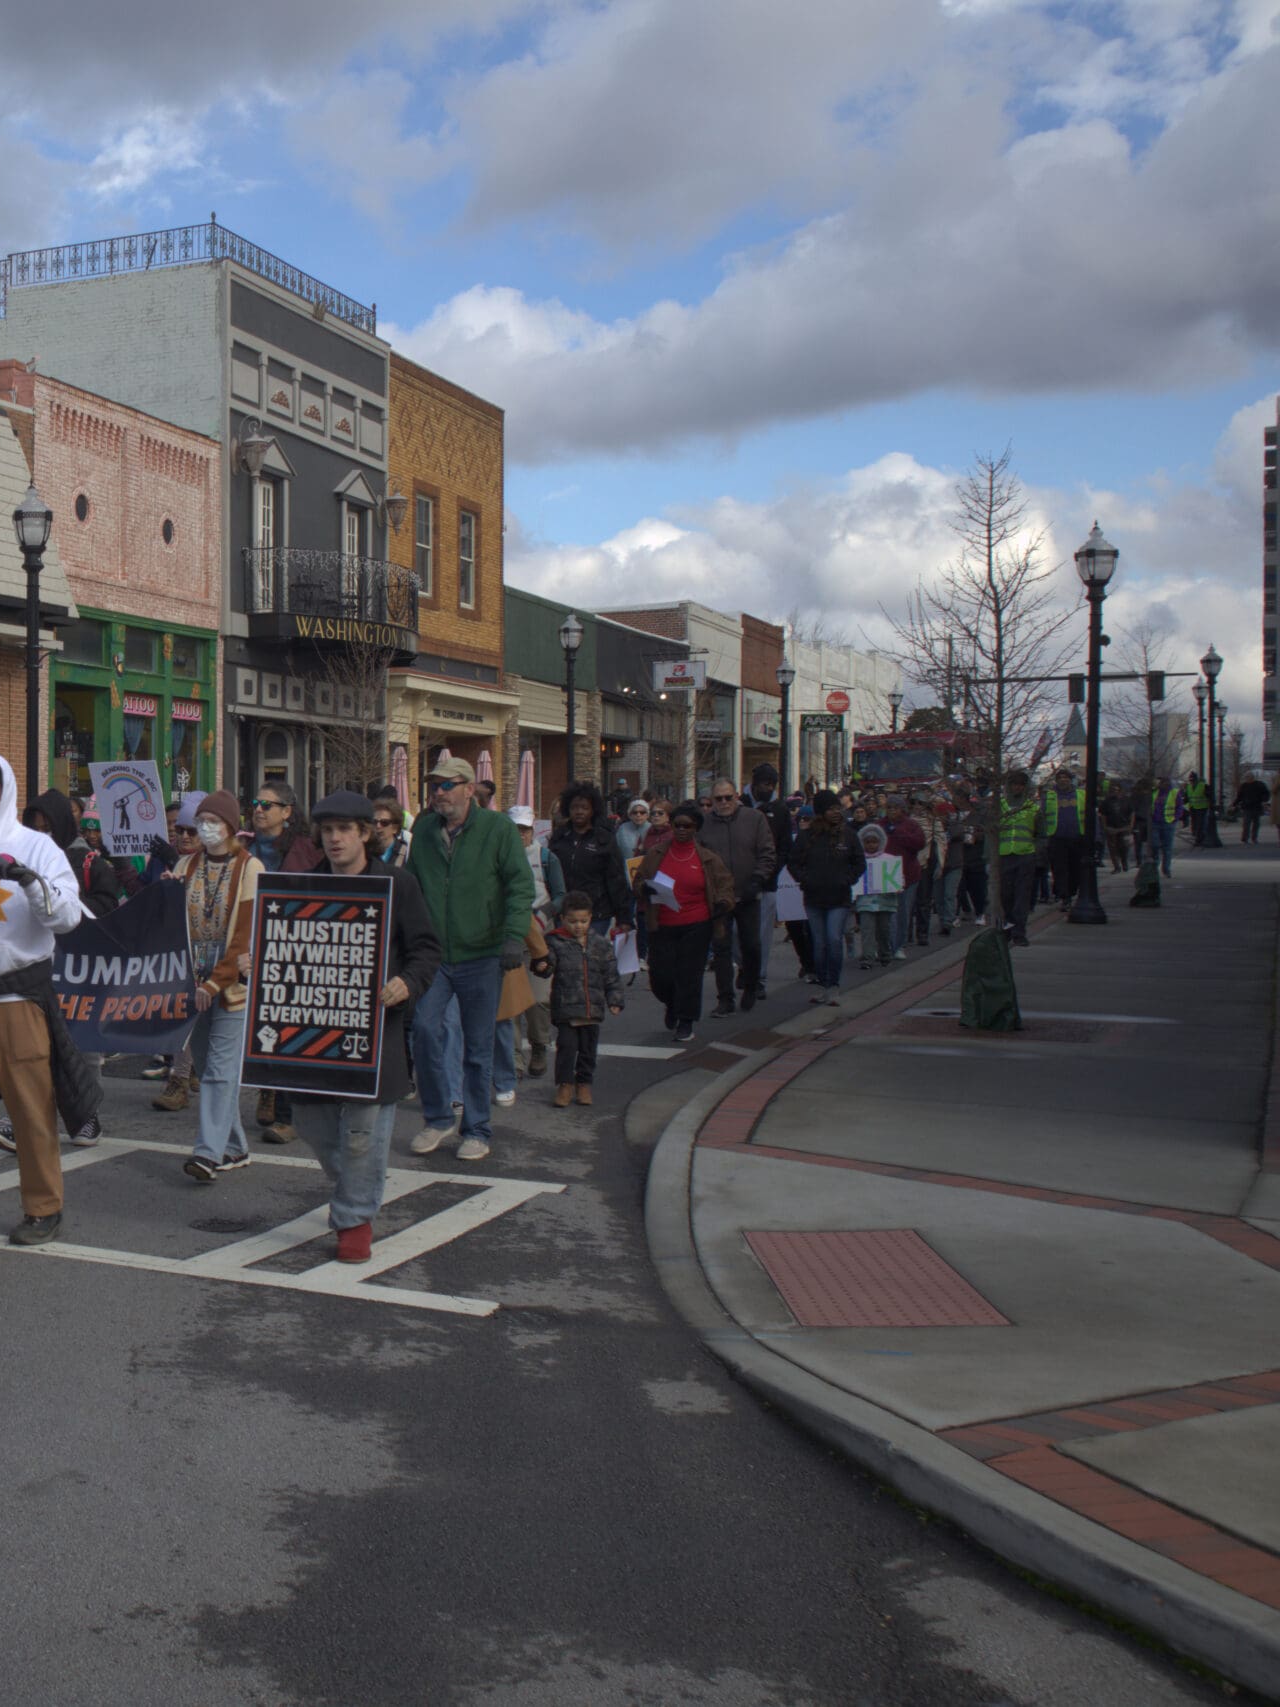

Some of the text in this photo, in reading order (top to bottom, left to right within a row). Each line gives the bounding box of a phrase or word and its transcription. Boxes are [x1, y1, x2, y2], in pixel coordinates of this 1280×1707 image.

[295, 615, 398, 647] WASHINGTON
[123, 696, 154, 713] ATTOO
[172, 702, 200, 718] ATTOO
[101, 765, 158, 793] BENDING THE ARC
[112, 834, 154, 844] WITH AL
[113, 844, 128, 854] MY
[265, 919, 376, 945] INJUSTICE
[264, 941, 375, 966] ANYWHERE
[52, 949, 187, 985] UMPKIN
[262, 963, 373, 987] IS A THREAT
[57, 992, 189, 1022] HE PEOPLE
[261, 984, 371, 1010] TO JUSTICE
[259, 1004, 370, 1028] EVERYWHERE
